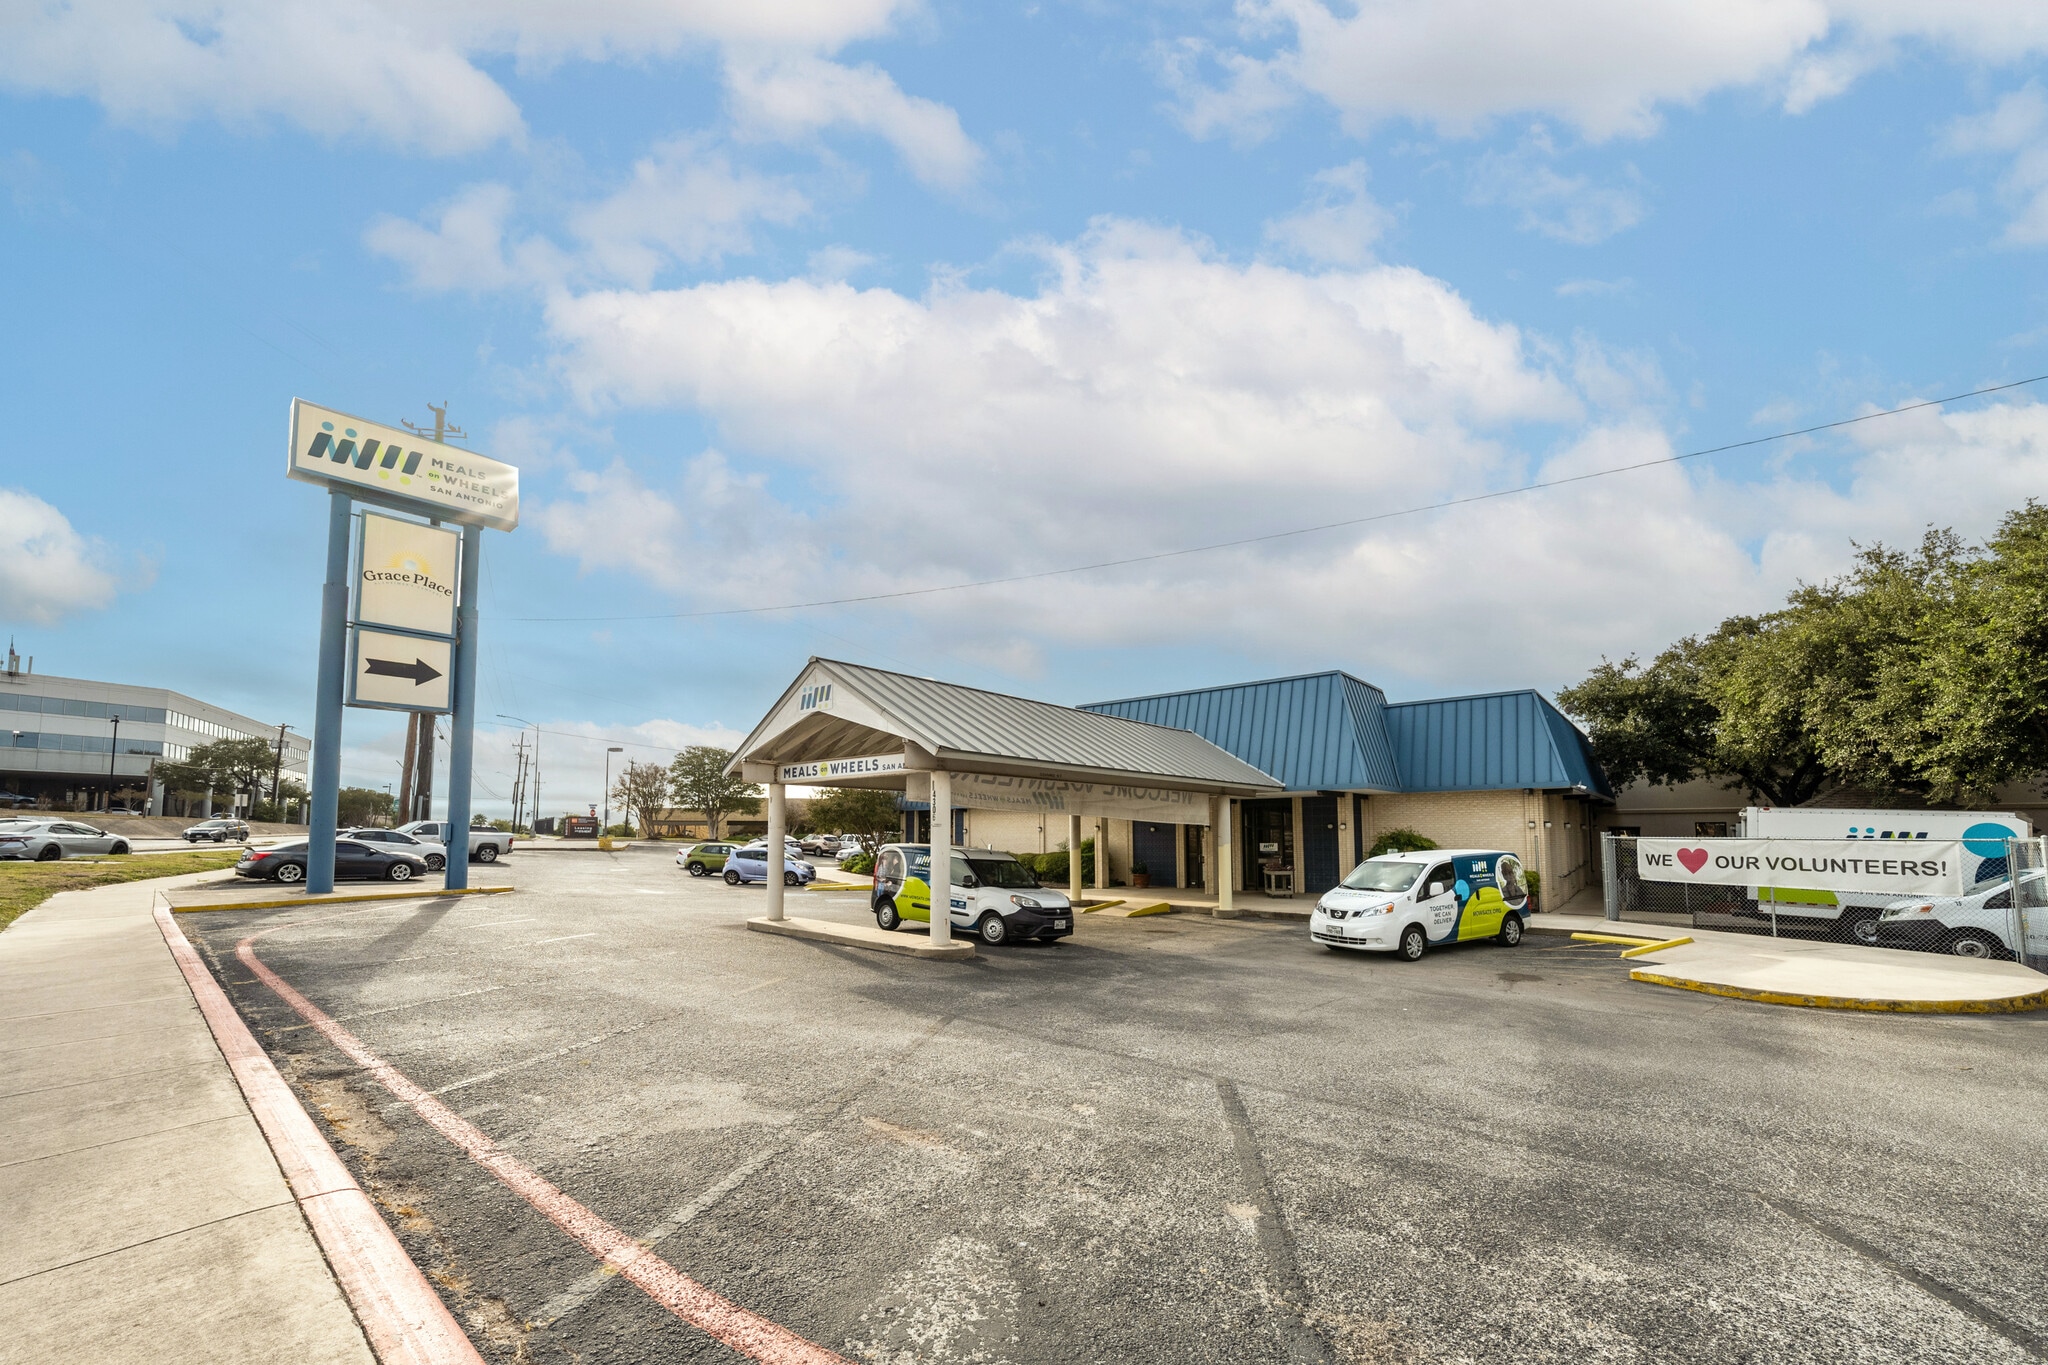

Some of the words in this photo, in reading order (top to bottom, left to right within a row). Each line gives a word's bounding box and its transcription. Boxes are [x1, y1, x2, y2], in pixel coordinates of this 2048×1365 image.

[431, 458, 486, 480] MEALS
[430, 485, 452, 496] SAN
[455, 492, 504, 509] ANTONIO
[443, 474, 509, 499] WHEELS
[363, 570, 410, 582] Grace
[413, 573, 453, 597] Place
[783, 765, 818, 779] MEALS
[830, 759, 879, 774] WHEELS
[1645, 853, 1673, 866] WE
[1715, 856, 1759, 870] OUR
[1766, 856, 1947, 877] VOLUNTEERS!
